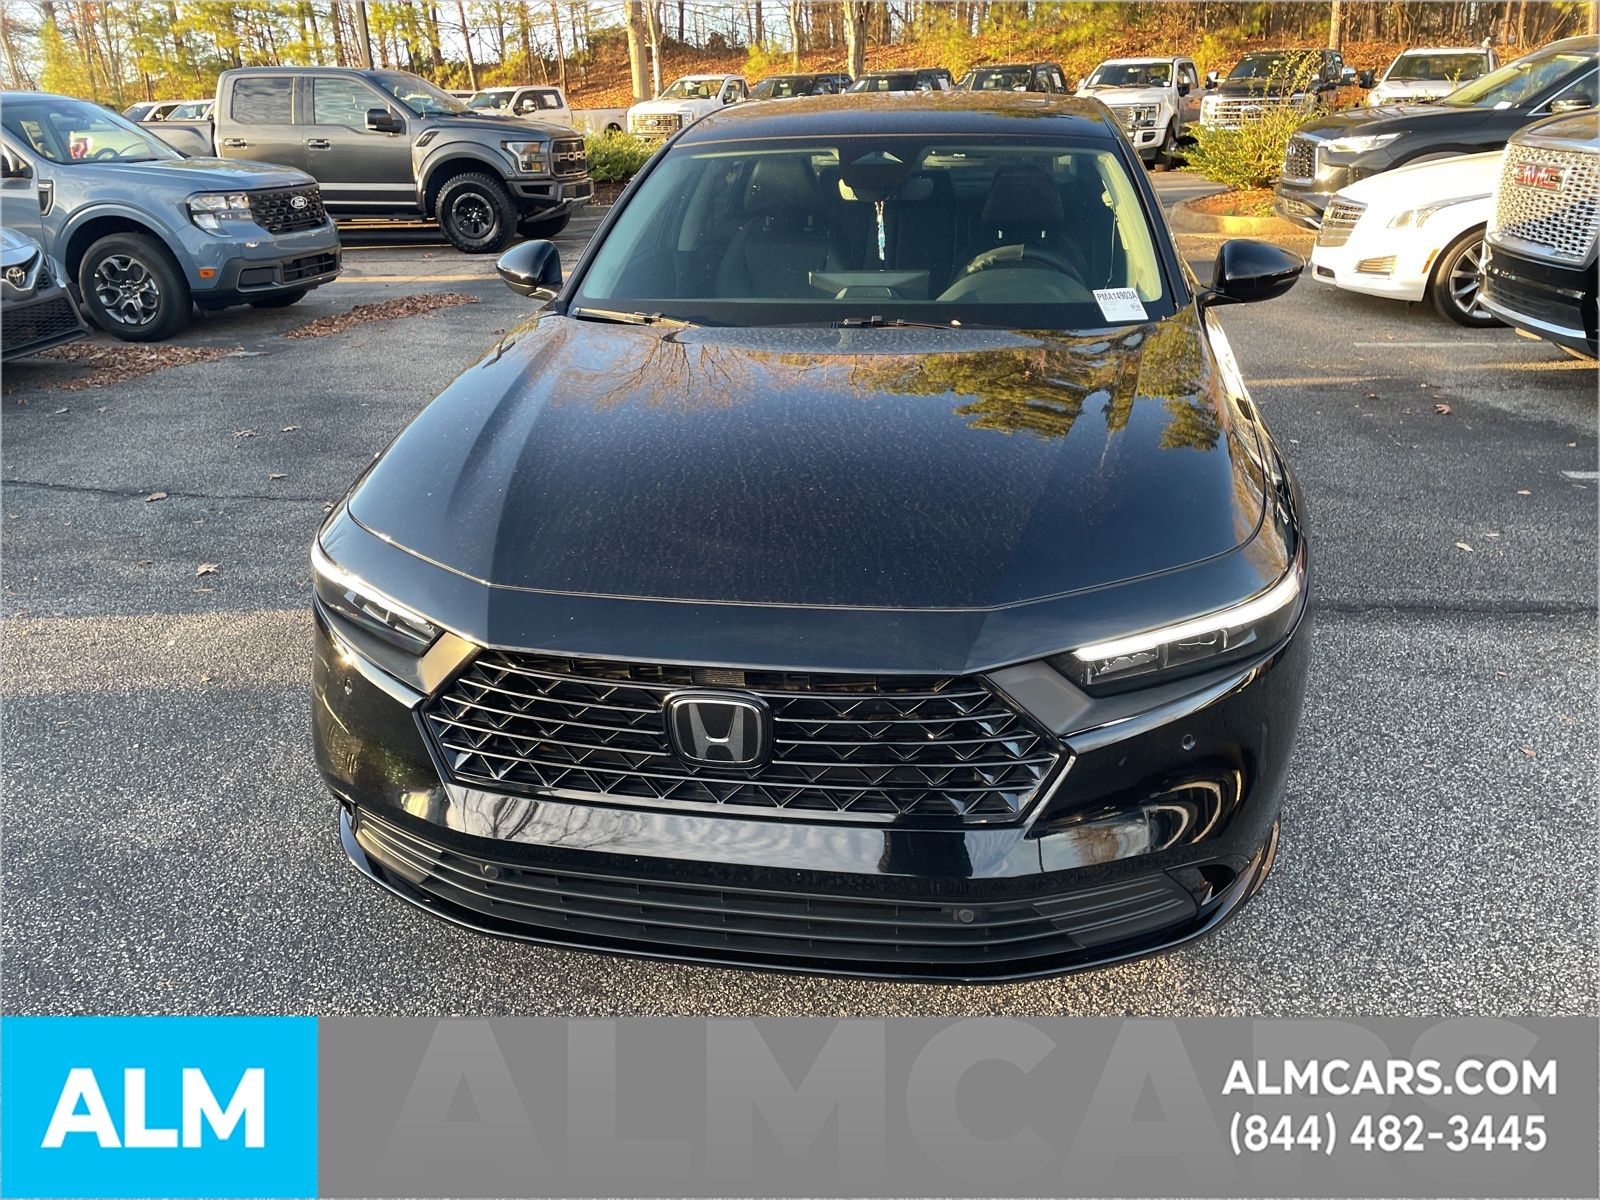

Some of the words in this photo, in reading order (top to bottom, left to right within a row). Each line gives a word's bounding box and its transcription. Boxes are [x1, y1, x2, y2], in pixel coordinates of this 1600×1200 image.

[558, 151, 586, 162] FORD
[1514, 162, 1563, 192] GMC
[1096, 291, 1138, 301] PMA14903A
